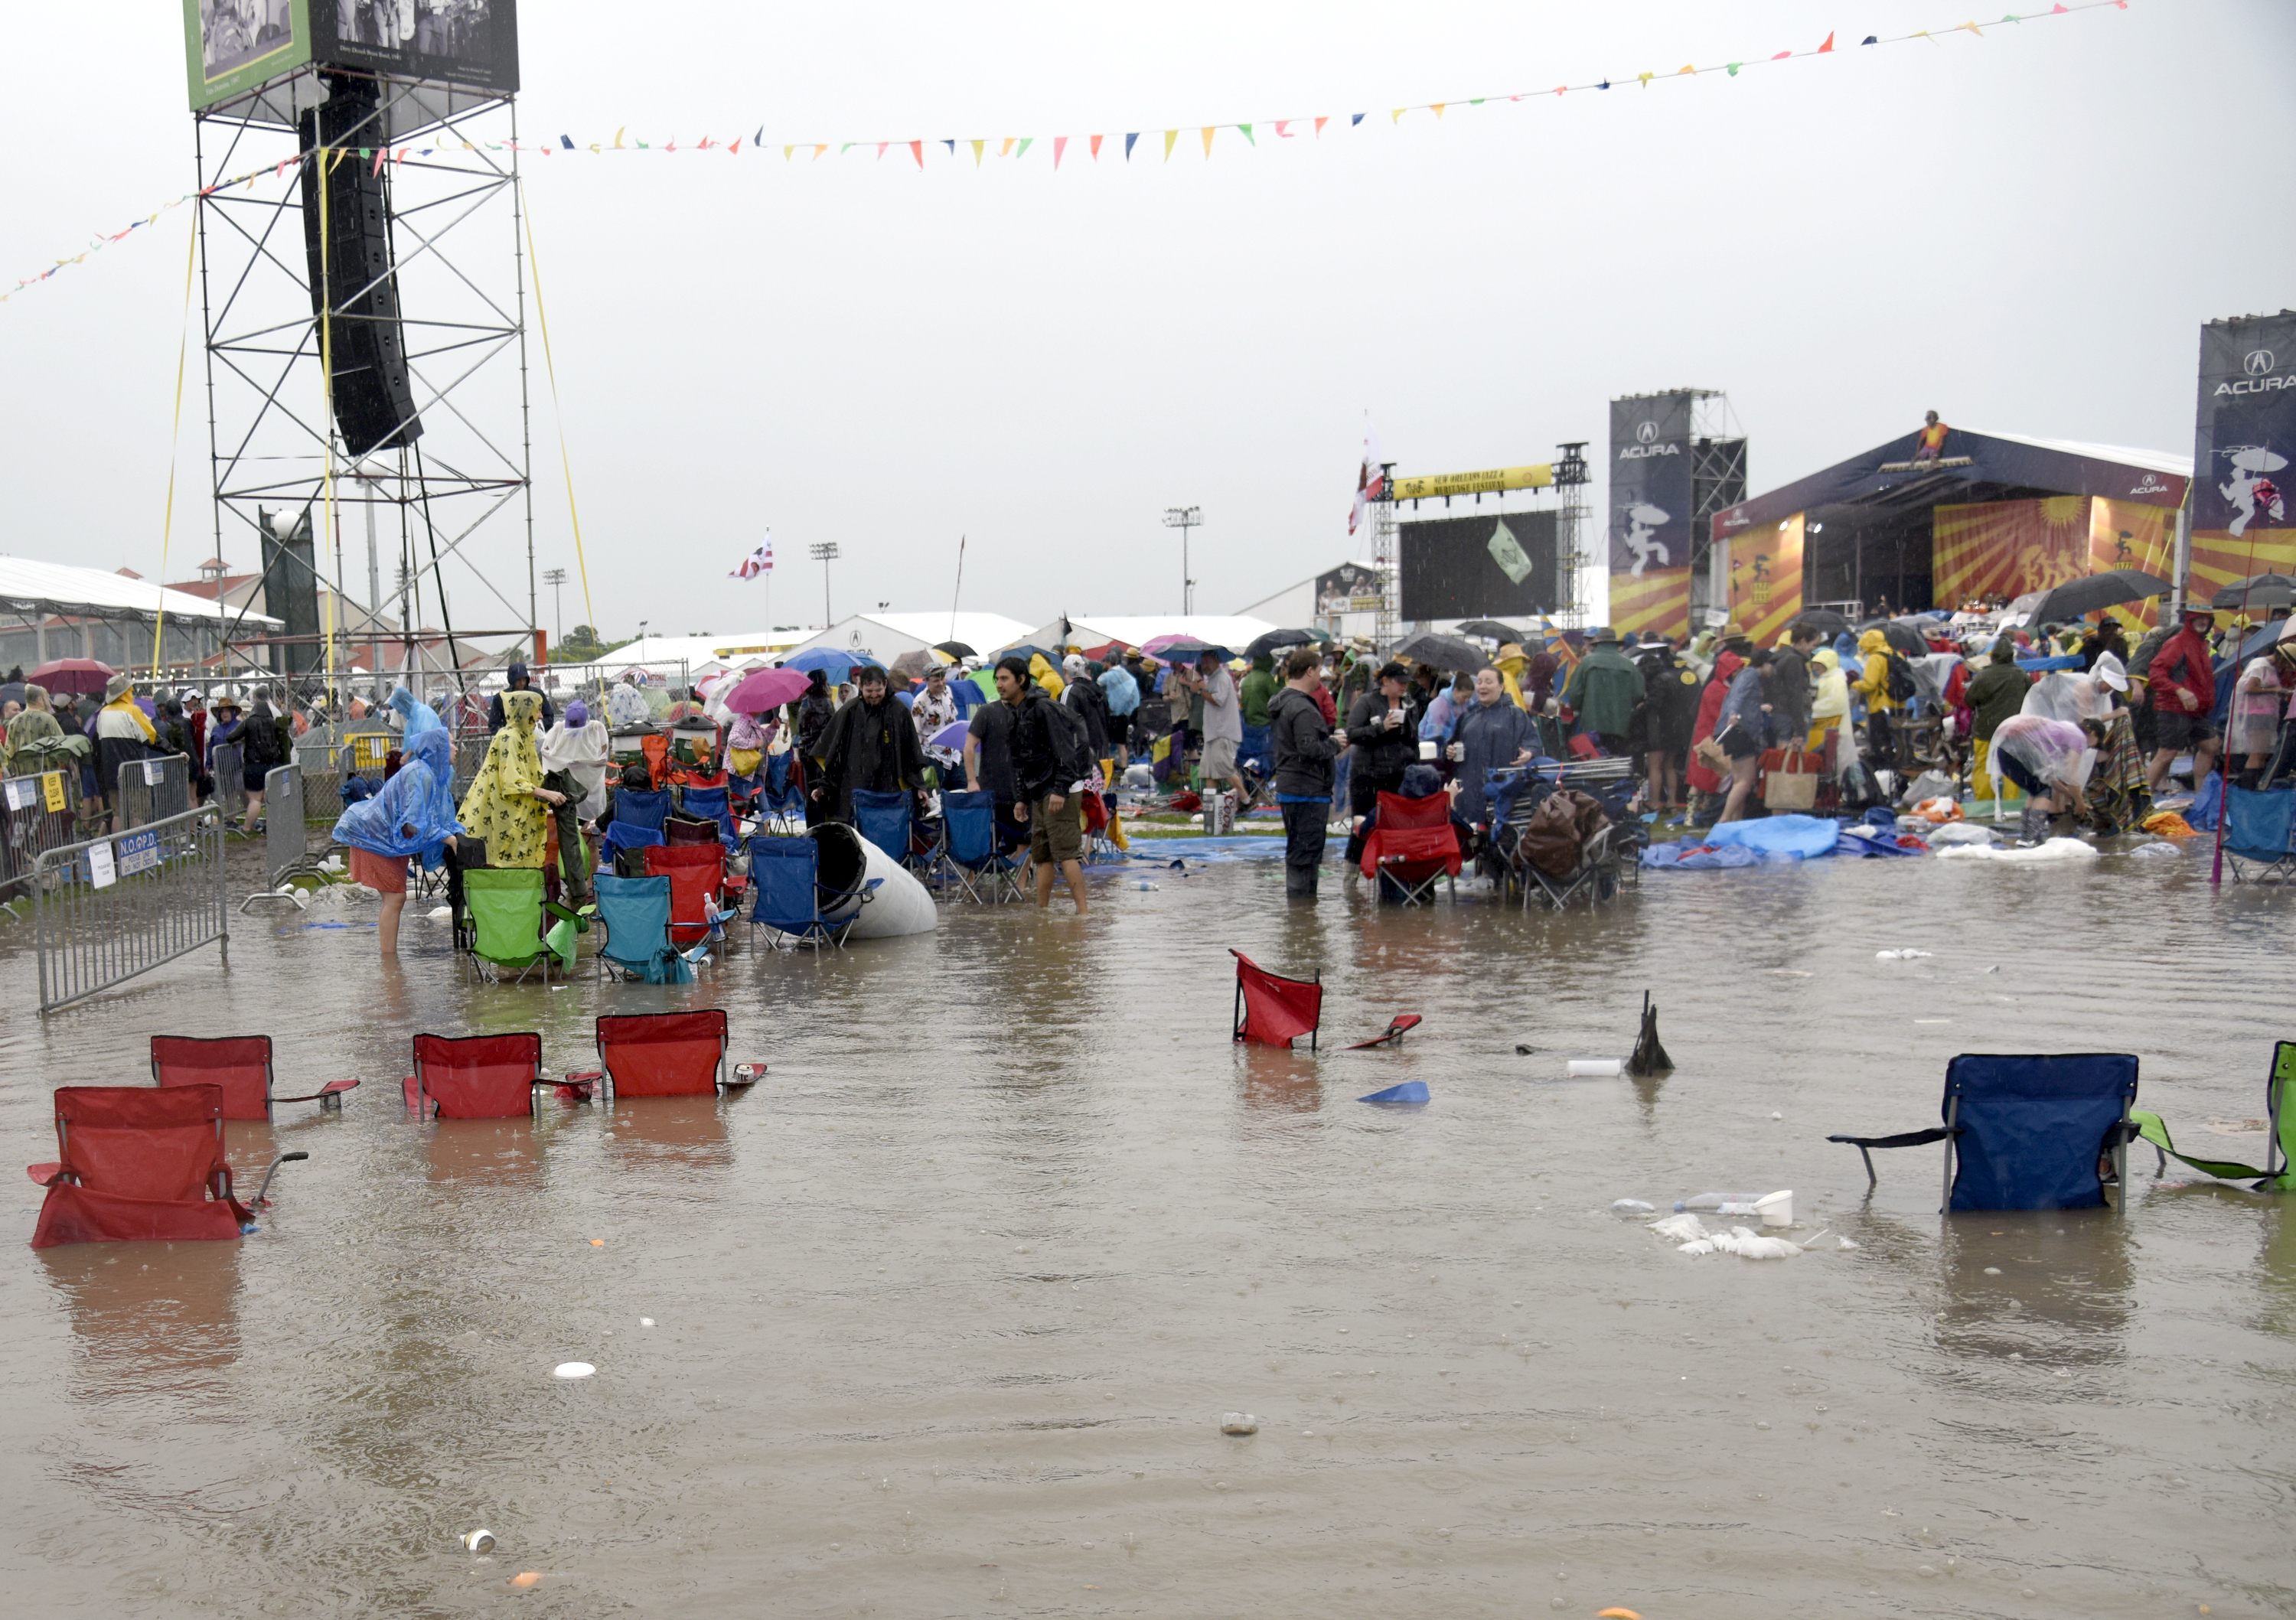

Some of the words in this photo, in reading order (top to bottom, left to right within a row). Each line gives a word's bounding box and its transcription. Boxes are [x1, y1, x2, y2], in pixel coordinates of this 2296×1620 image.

[2213, 375, 2296, 396] ACURA
[1619, 443, 1680, 460] ACURA
[1433, 474, 1447, 484] NEW
[1450, 471, 1480, 484] ORLEANS
[1433, 482, 1470, 495] HERITAGE
[1473, 480, 1506, 492] FESTIVAL
[2129, 485, 2168, 494] ACURA
[49, 788, 60, 798] CLEAR
[129, 853, 141, 862] POLICE
[132, 862, 141, 871] NOT
[143, 857, 155, 867] CROSS
